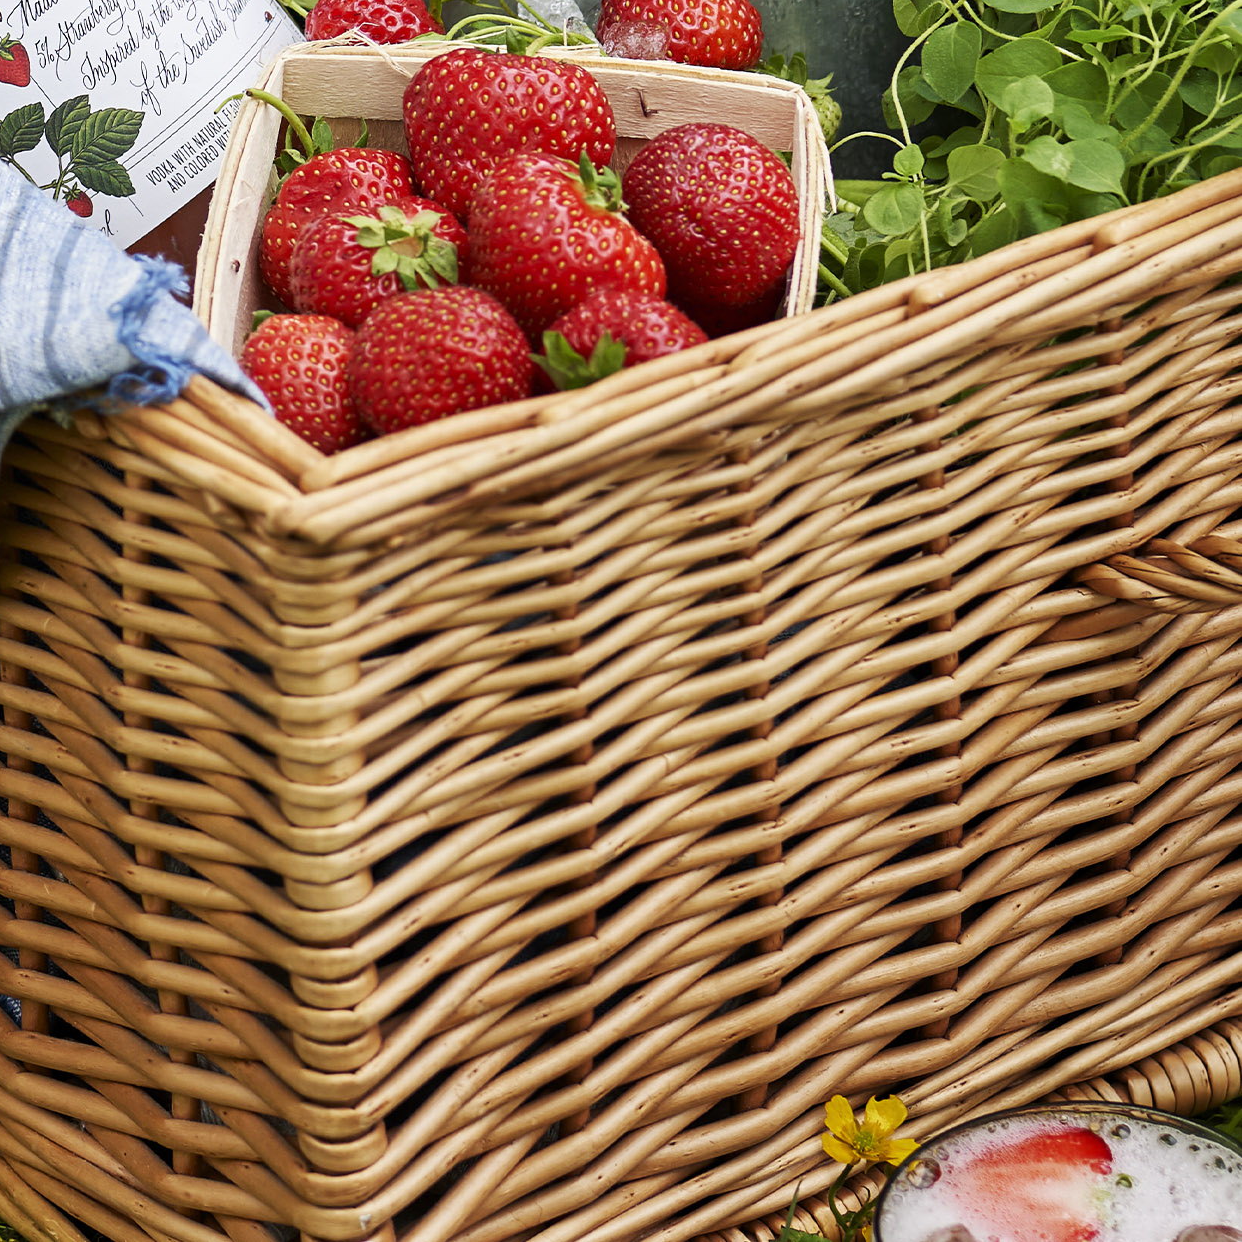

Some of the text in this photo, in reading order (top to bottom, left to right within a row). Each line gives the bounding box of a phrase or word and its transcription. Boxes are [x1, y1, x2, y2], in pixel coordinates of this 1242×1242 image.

[35, 36, 55, 69] 5%
[80, 25, 139, 89] Inspired
[137, 9, 161, 50] by
[130, 61, 162, 117] of
[156, 51, 181, 89] the
[180, 0, 226, 84] Swedish
[146, 159, 176, 186] VODKA
[171, 142, 196, 166] WITH
[192, 116, 227, 151] NATURAL
[166, 170, 186, 193] AND
[188, 145, 219, 179] COLORED
